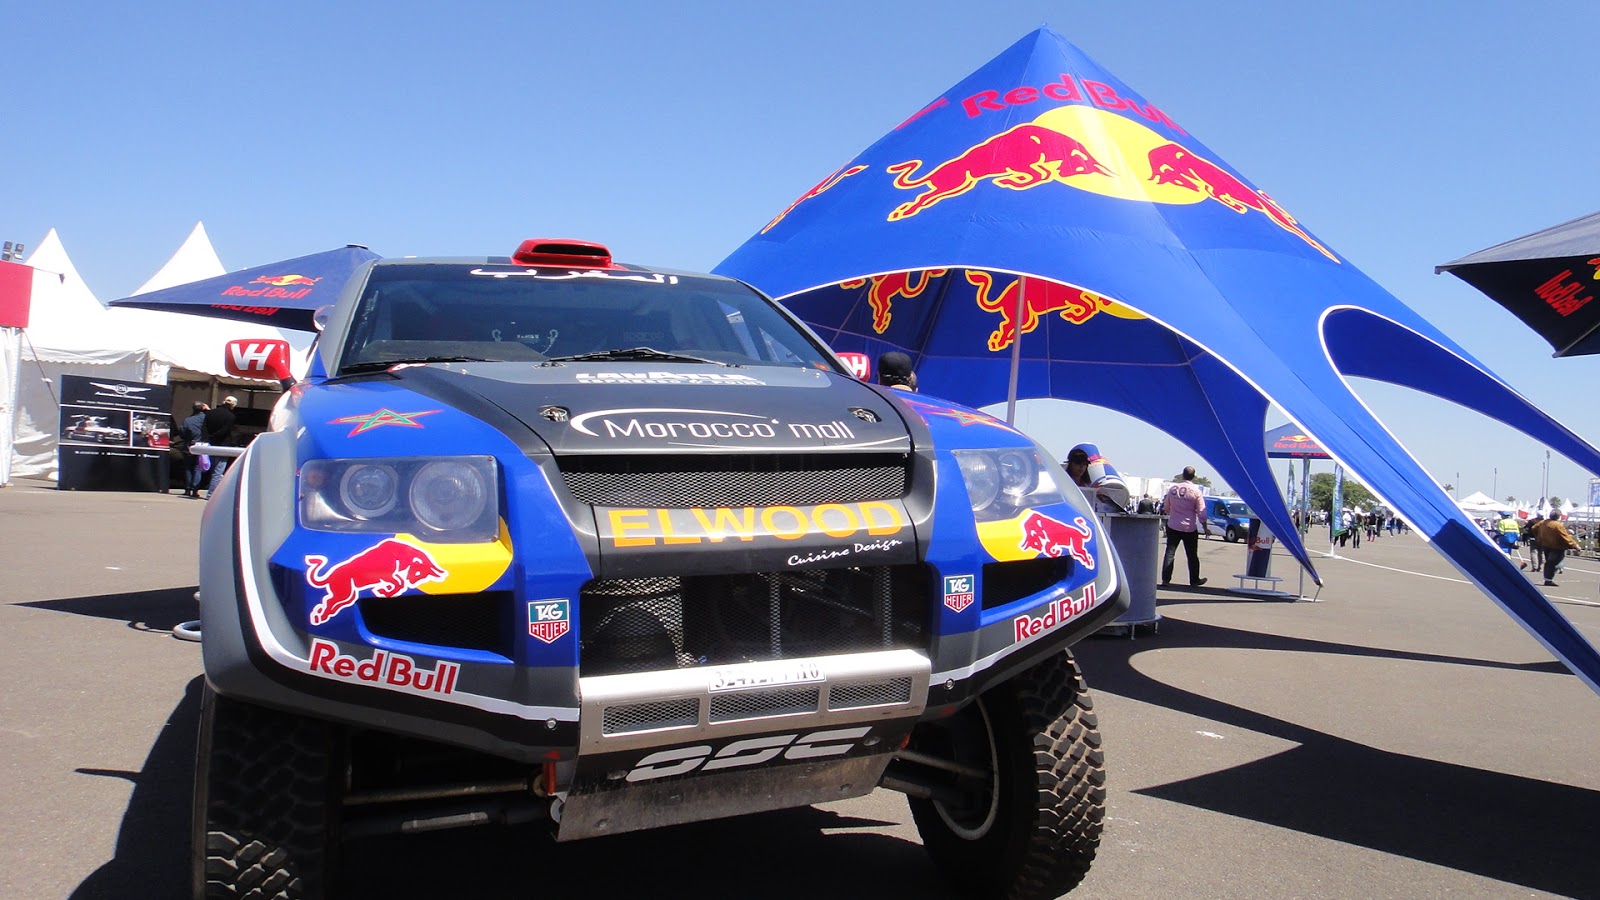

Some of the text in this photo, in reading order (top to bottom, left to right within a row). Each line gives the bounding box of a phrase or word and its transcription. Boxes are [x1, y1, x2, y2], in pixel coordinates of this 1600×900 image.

[962, 73, 1083, 118] Red
[221, 286, 313, 299] Red Bull
[231, 343, 276, 371] VH
[603, 418, 855, 440] Morocco mall
[1273, 441, 1298, 449] Red
[608, 502, 903, 547] ELWOOD
[787, 539, 903, 566] Cuisine Design
[949, 577, 970, 593] TAG
[535, 603, 563, 620] TAG
[945, 593, 972, 610] HEUER
[1015, 584, 1096, 642] Red Bull
[532, 622, 567, 640] HEUER
[310, 641, 457, 694] Red Bull
